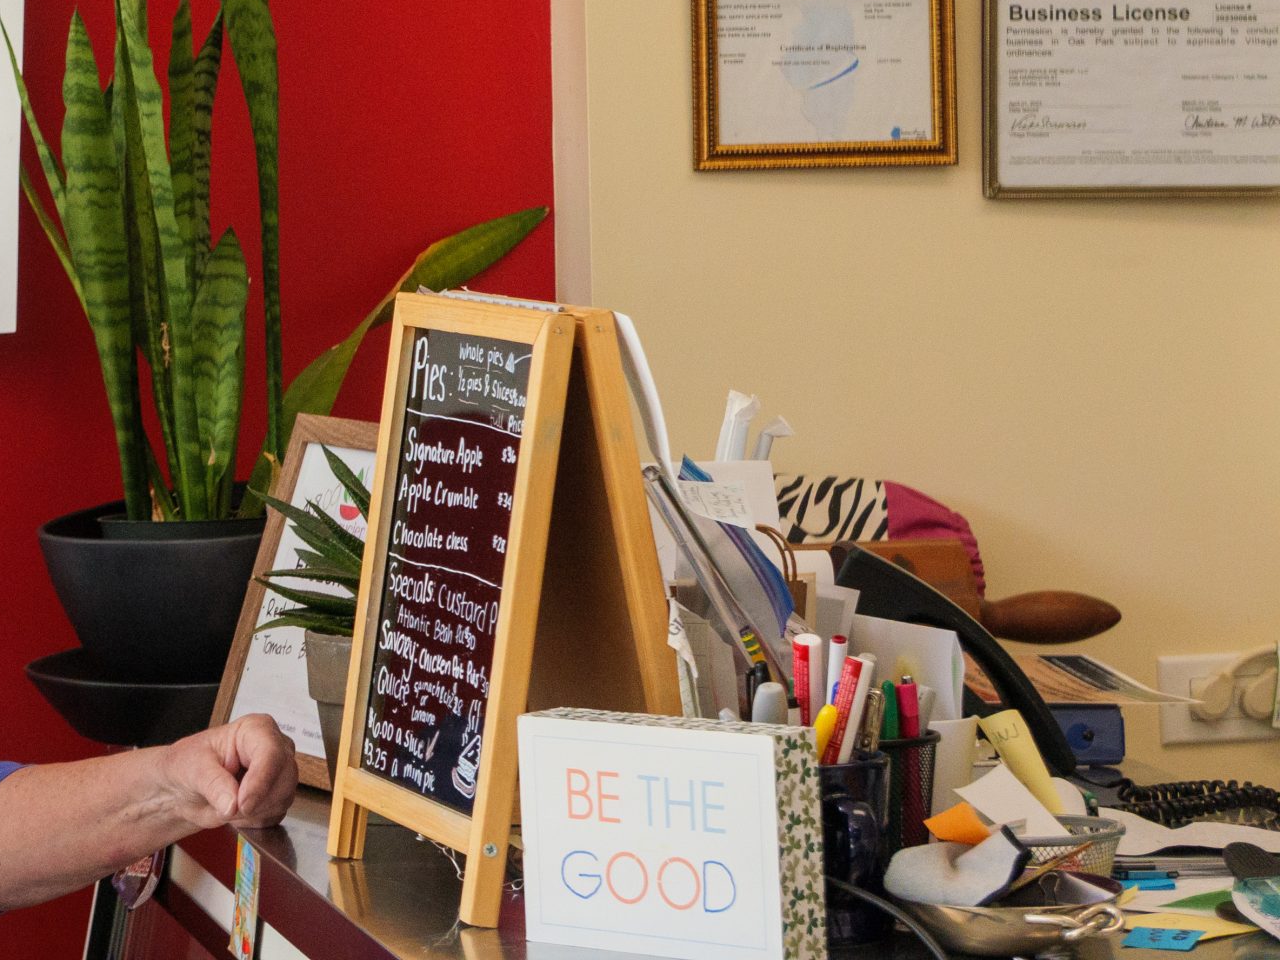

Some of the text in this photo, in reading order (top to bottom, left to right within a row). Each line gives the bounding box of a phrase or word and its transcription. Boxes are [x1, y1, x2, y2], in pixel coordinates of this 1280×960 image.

[1009, 3, 1190, 22] Business License
[487, 347, 504, 372] pies
[405, 426, 455, 474] Signature
[456, 437, 483, 473] Apple
[398, 474, 431, 513] Apple
[434, 481, 479, 509] Crumble
[393, 520, 443, 549] Chocolate
[389, 562, 489, 633] Specials: Custard
[397, 603, 431, 637] Atlantic
[263, 634, 292, 655] Tomato
[368, 707, 394, 742] $6.00
[395, 727, 402, 746] a
[364, 738, 388, 771] $3.25
[391, 758, 398, 777] a
[403, 760, 424, 786] mini
[566, 767, 726, 835] BE THE
[561, 850, 736, 914] GOOD
